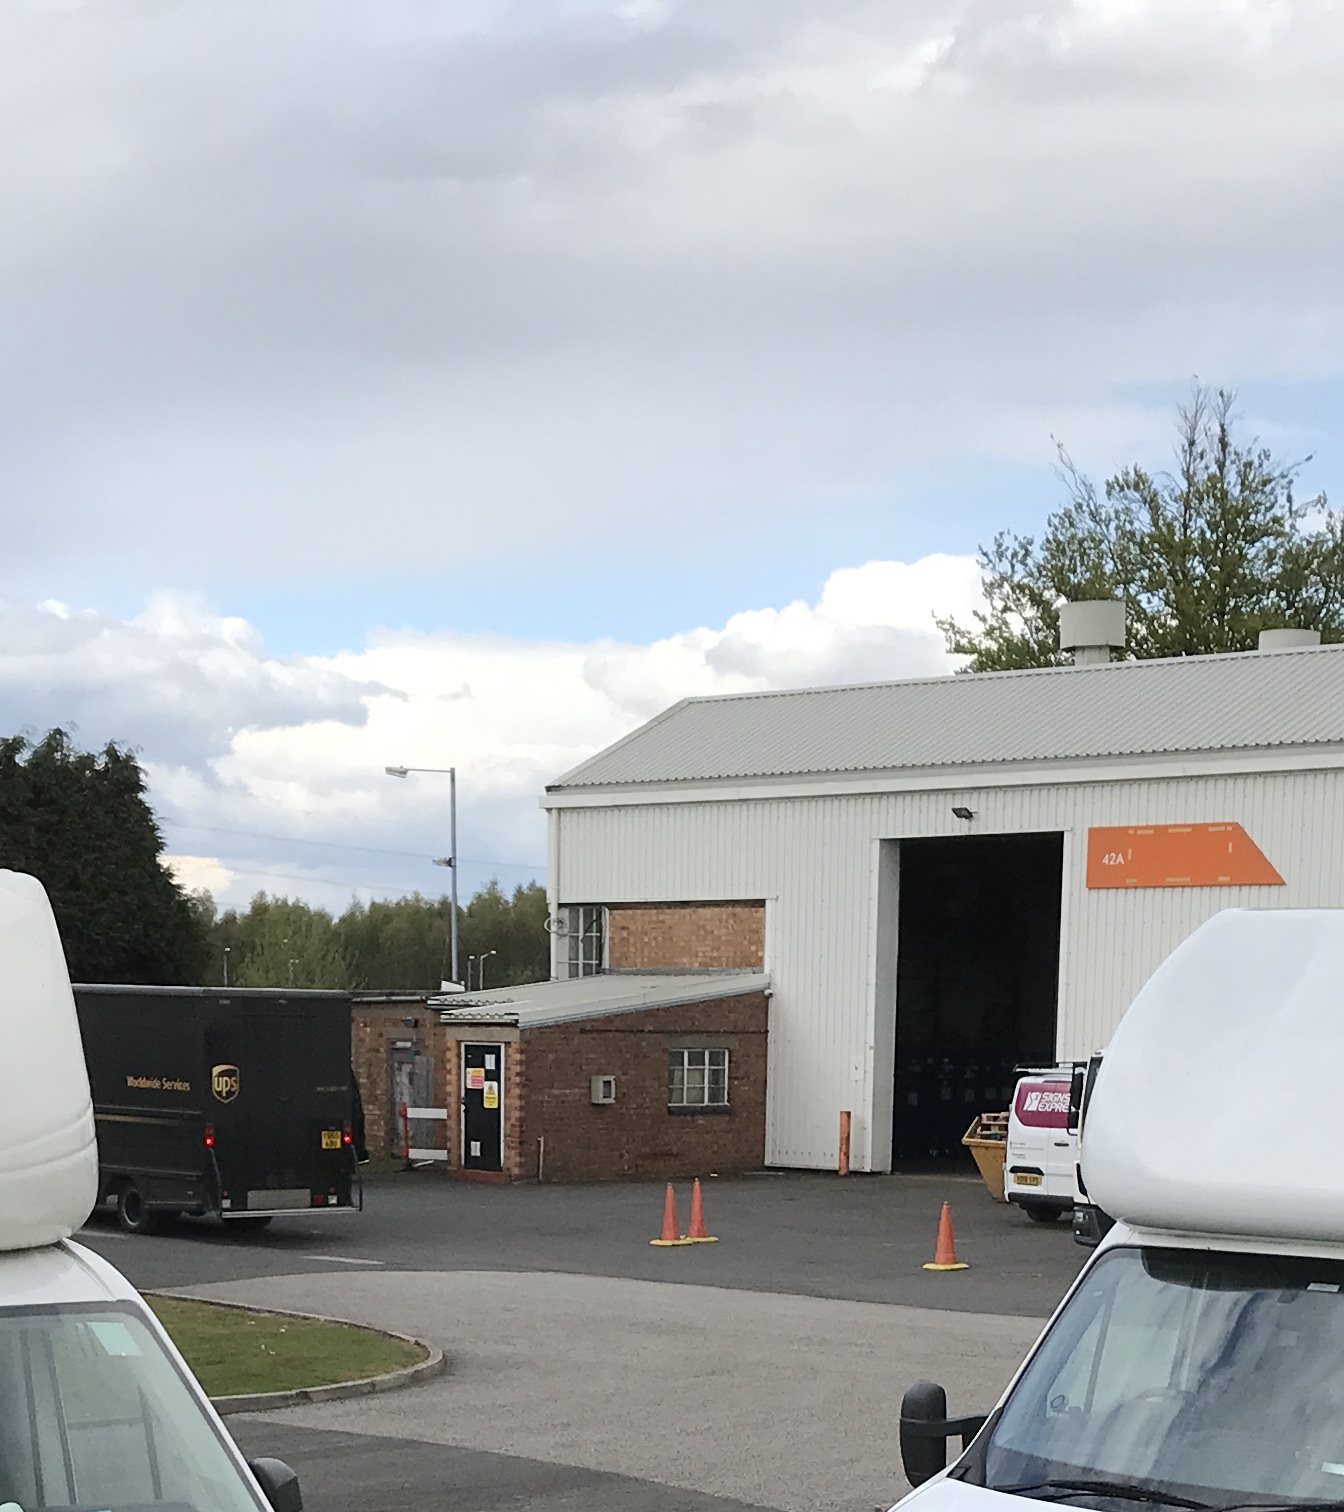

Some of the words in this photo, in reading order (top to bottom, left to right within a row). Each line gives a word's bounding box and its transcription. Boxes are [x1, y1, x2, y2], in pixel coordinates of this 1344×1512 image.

[1101, 851, 1125, 866] 42A
[162, 1077, 191, 1092] Services
[213, 1075, 238, 1097] ups
[1041, 1092, 1071, 1102] SIGNS
[1038, 1102, 1075, 1112] EXPRE
